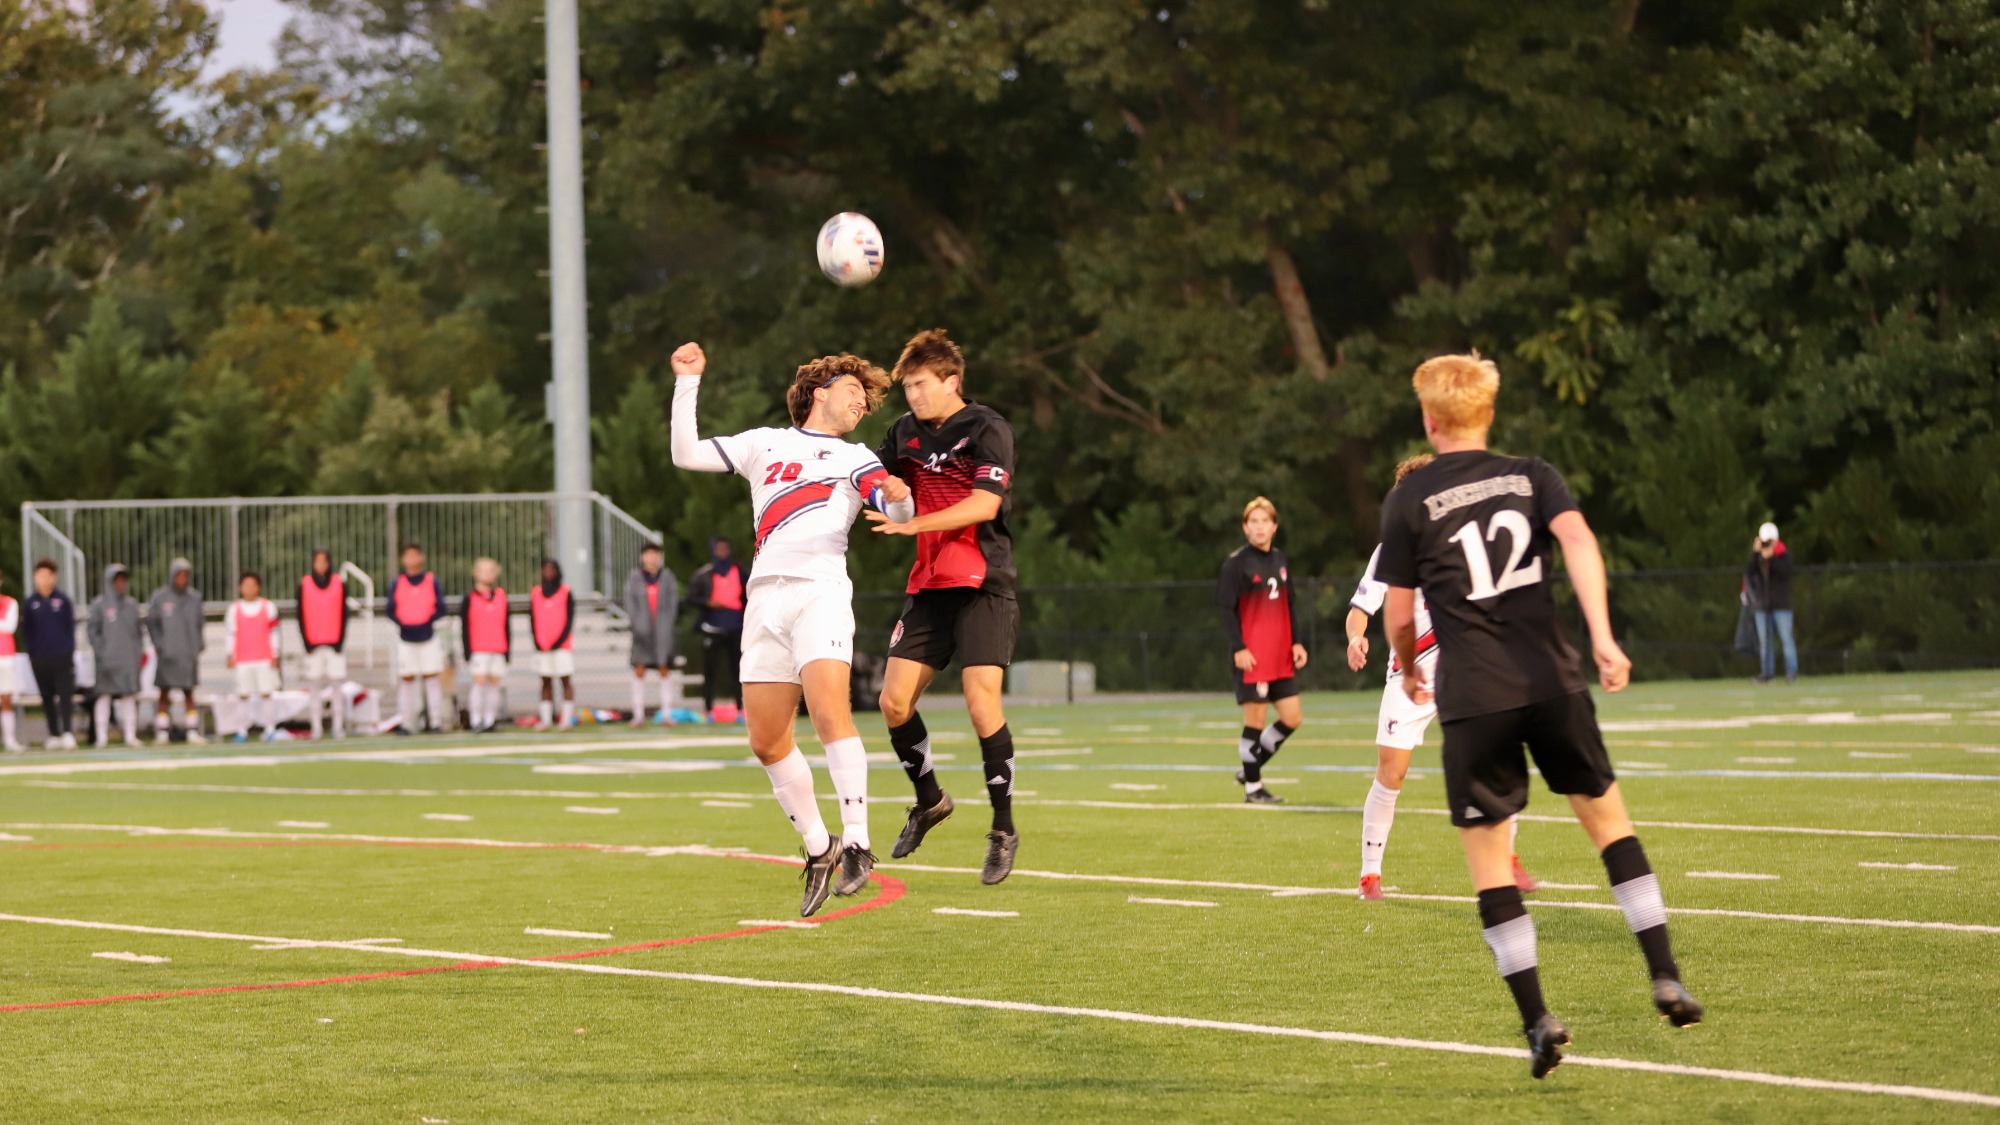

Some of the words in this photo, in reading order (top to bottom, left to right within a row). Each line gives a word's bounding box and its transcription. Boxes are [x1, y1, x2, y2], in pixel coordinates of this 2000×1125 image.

[989, 467, 1005, 481] C
[1448, 509, 1542, 600] 12
[1267, 576, 1280, 600] 2
